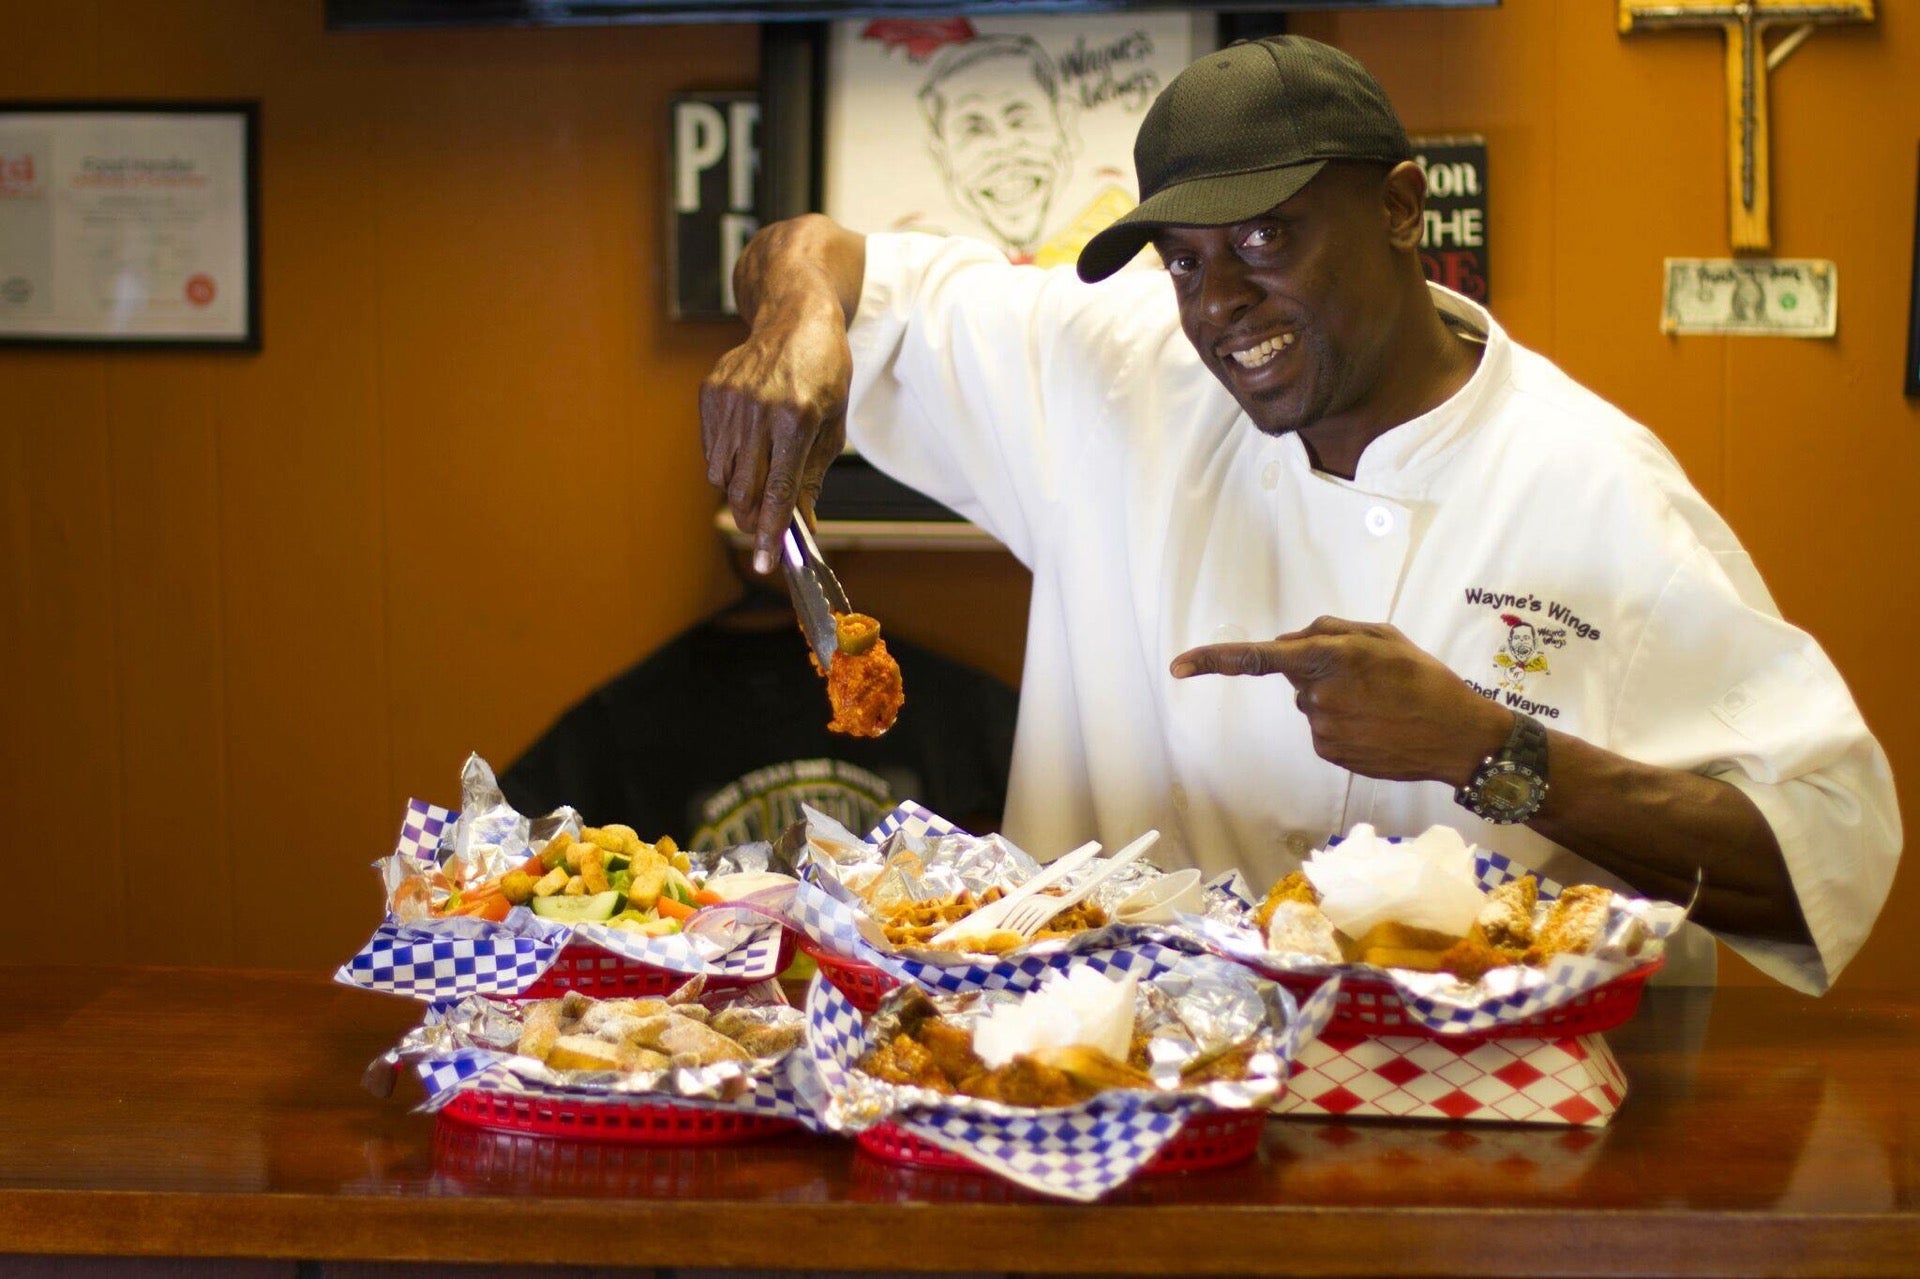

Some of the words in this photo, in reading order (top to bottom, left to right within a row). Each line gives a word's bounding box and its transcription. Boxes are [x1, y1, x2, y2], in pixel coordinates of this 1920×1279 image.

[1419, 208, 1484, 248] THE
[1465, 588, 1542, 612] Wayne's
[1548, 602, 1601, 641] Wings
[1506, 691, 1560, 719] Wayne
